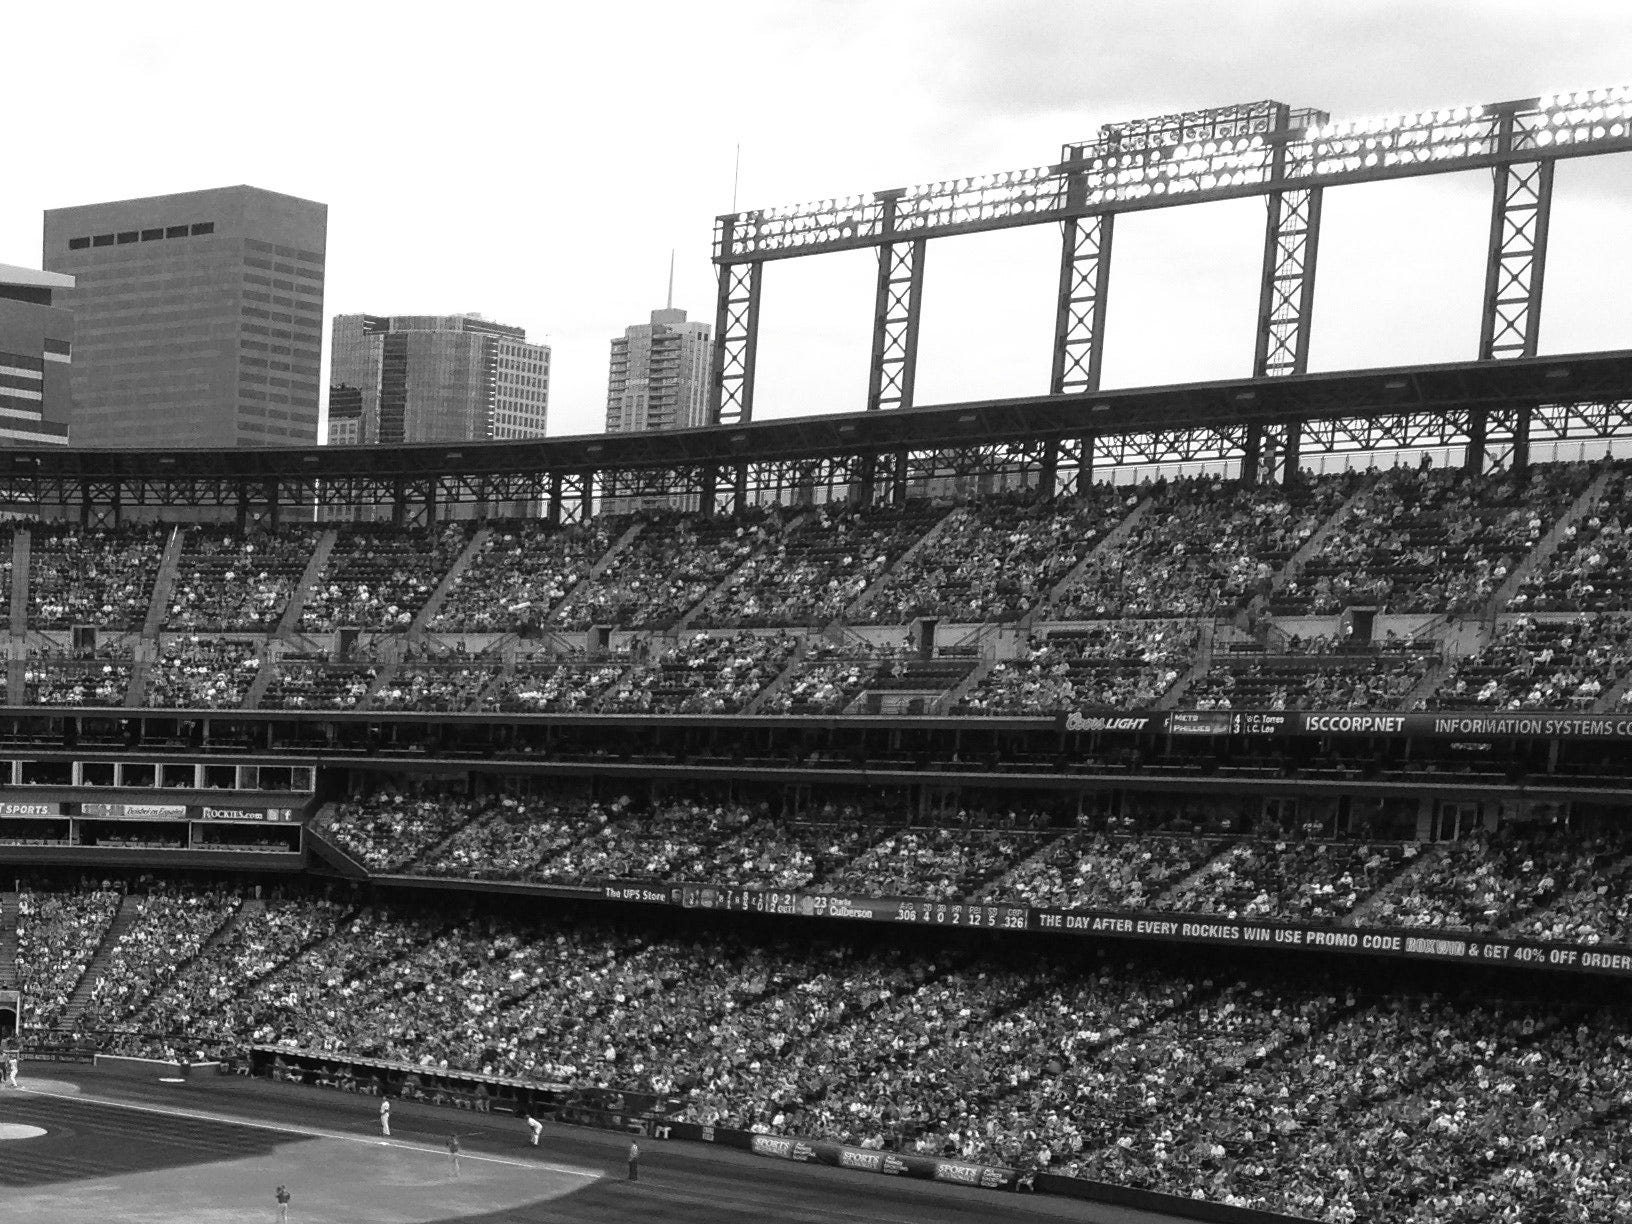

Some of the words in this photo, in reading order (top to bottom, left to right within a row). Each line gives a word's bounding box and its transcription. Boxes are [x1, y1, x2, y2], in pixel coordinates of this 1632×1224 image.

[1105, 718, 1149, 729] LIGHT
[1234, 714, 1241, 723] 4
[1305, 716, 1406, 732] ISCCORP.NET
[1234, 724, 1240, 733] 3
[1435, 718, 1542, 734] INFORMATION
[1546, 720, 1613, 735] SYSTEMS
[6, 804, 48, 815] SPORTS
[605, 887, 621, 899] The
[623, 888, 641, 900] UPS
[642, 890, 666, 902] Store
[757, 902, 763, 911] 0
[814, 897, 827, 908] 23
[830, 905, 873, 919] Culberson
[895, 909, 916, 921] .306
[923, 911, 930, 922] 4
[937, 912, 945, 923] 0
[952, 913, 960, 924] 2
[969, 914, 981, 926] 12
[988, 915, 996, 926] 5
[1001, 916, 1024, 928] .326
[1039, 914, 1062, 927] THE
[1066, 916, 1090, 929] DAY
[1093, 918, 1133, 932] AFTER
[1137, 920, 1179, 935] EVERY
[1182, 923, 1240, 939] ROCKIES
[1244, 927, 1269, 941] WIN
[1275, 929, 1302, 944] USE
[1306, 931, 1358, 947] PROMO
[1362, 934, 1401, 950] CODE
[1469, 943, 1479, 957] &
[1483, 944, 1510, 959] GET
[1513, 947, 1546, 963] 40%
[1550, 949, 1577, 964] OFF
[1582, 952, 1632, 971] ORDER
